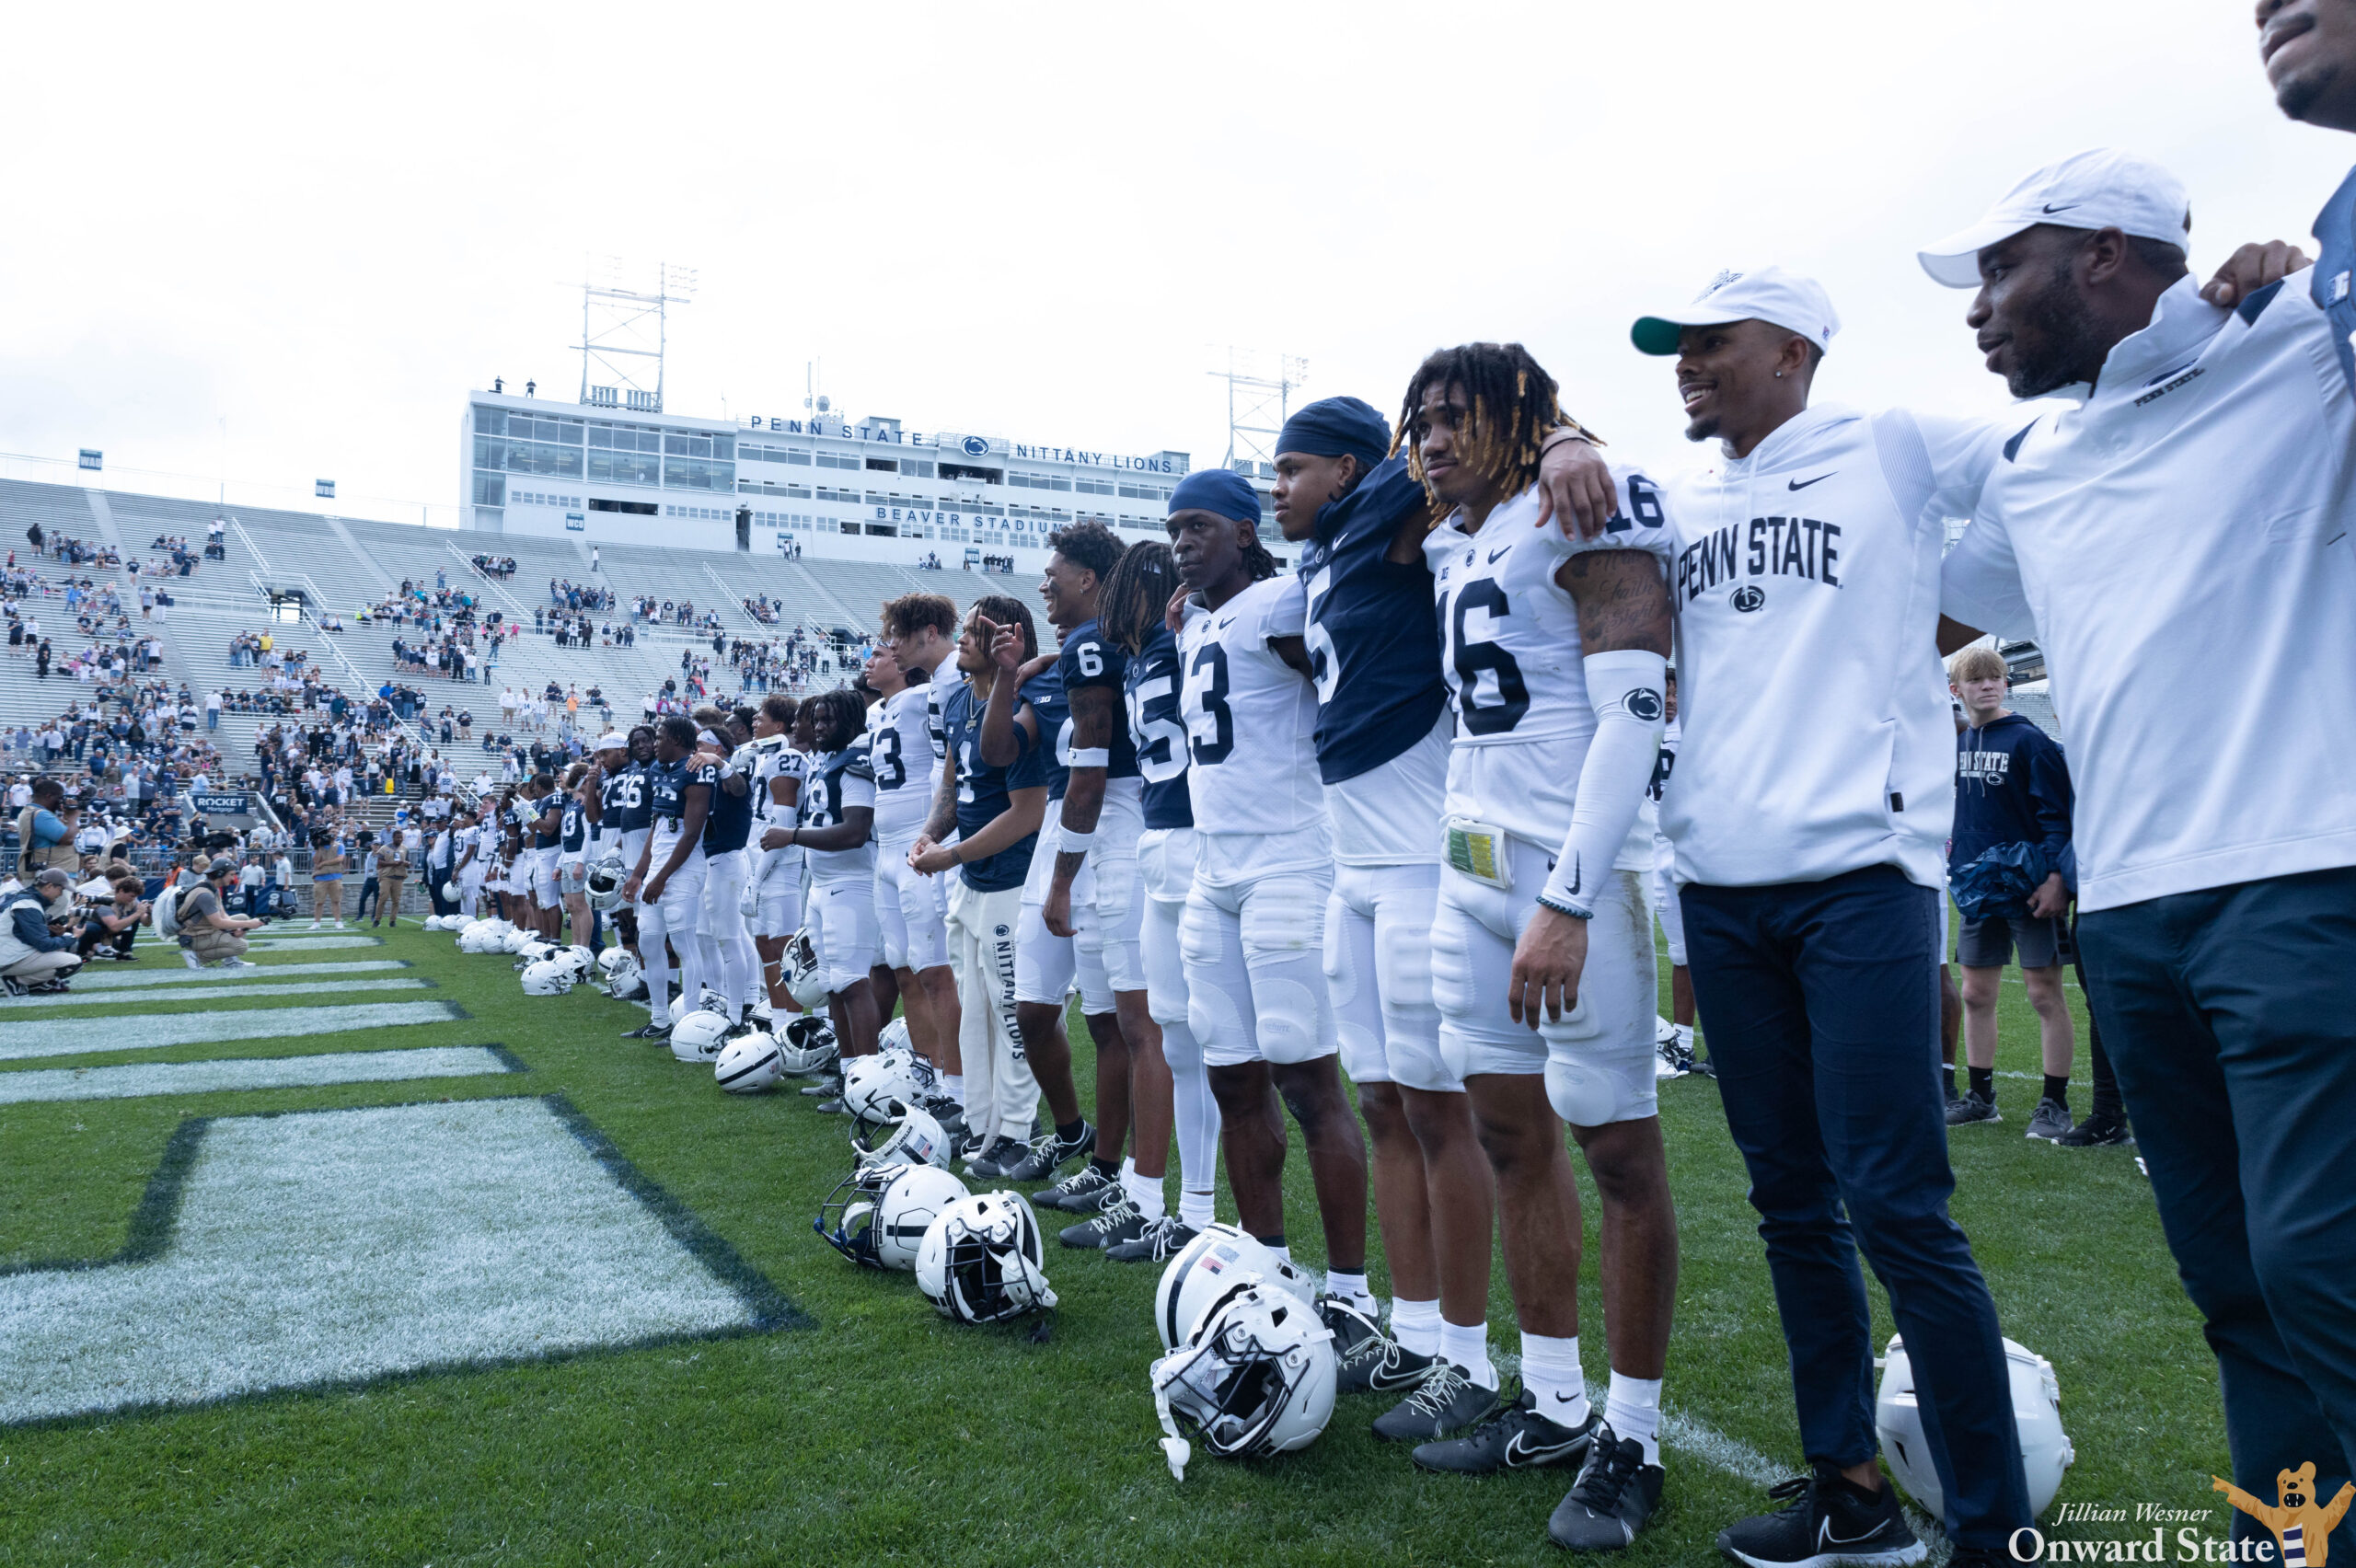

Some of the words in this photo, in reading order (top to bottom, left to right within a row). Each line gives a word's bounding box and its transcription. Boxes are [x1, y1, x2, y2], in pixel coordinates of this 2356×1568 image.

[751, 415, 822, 435] PENN
[841, 425, 922, 446] STATE
[1017, 444, 1103, 466] NITTANY
[1114, 455, 1172, 474] LIONS
[1606, 474, 1665, 535] 16
[877, 507, 960, 525] BEAVER
[975, 515, 1063, 533] STADIUM
[1679, 523, 1738, 614] PENN
[1749, 516, 1842, 587] STATE
[1078, 641, 1103, 677] 6
[697, 766, 716, 783] 12
[778, 755, 803, 771] 27
[957, 741, 975, 803] 1
[1974, 751, 2010, 772] STATE
[198, 798, 244, 806] ROCKET
[552, 795, 562, 804] 11
[503, 815, 514, 825] 31
[997, 940, 1017, 1010] NITTANY
[1003, 1013, 1026, 1060] LIONS
